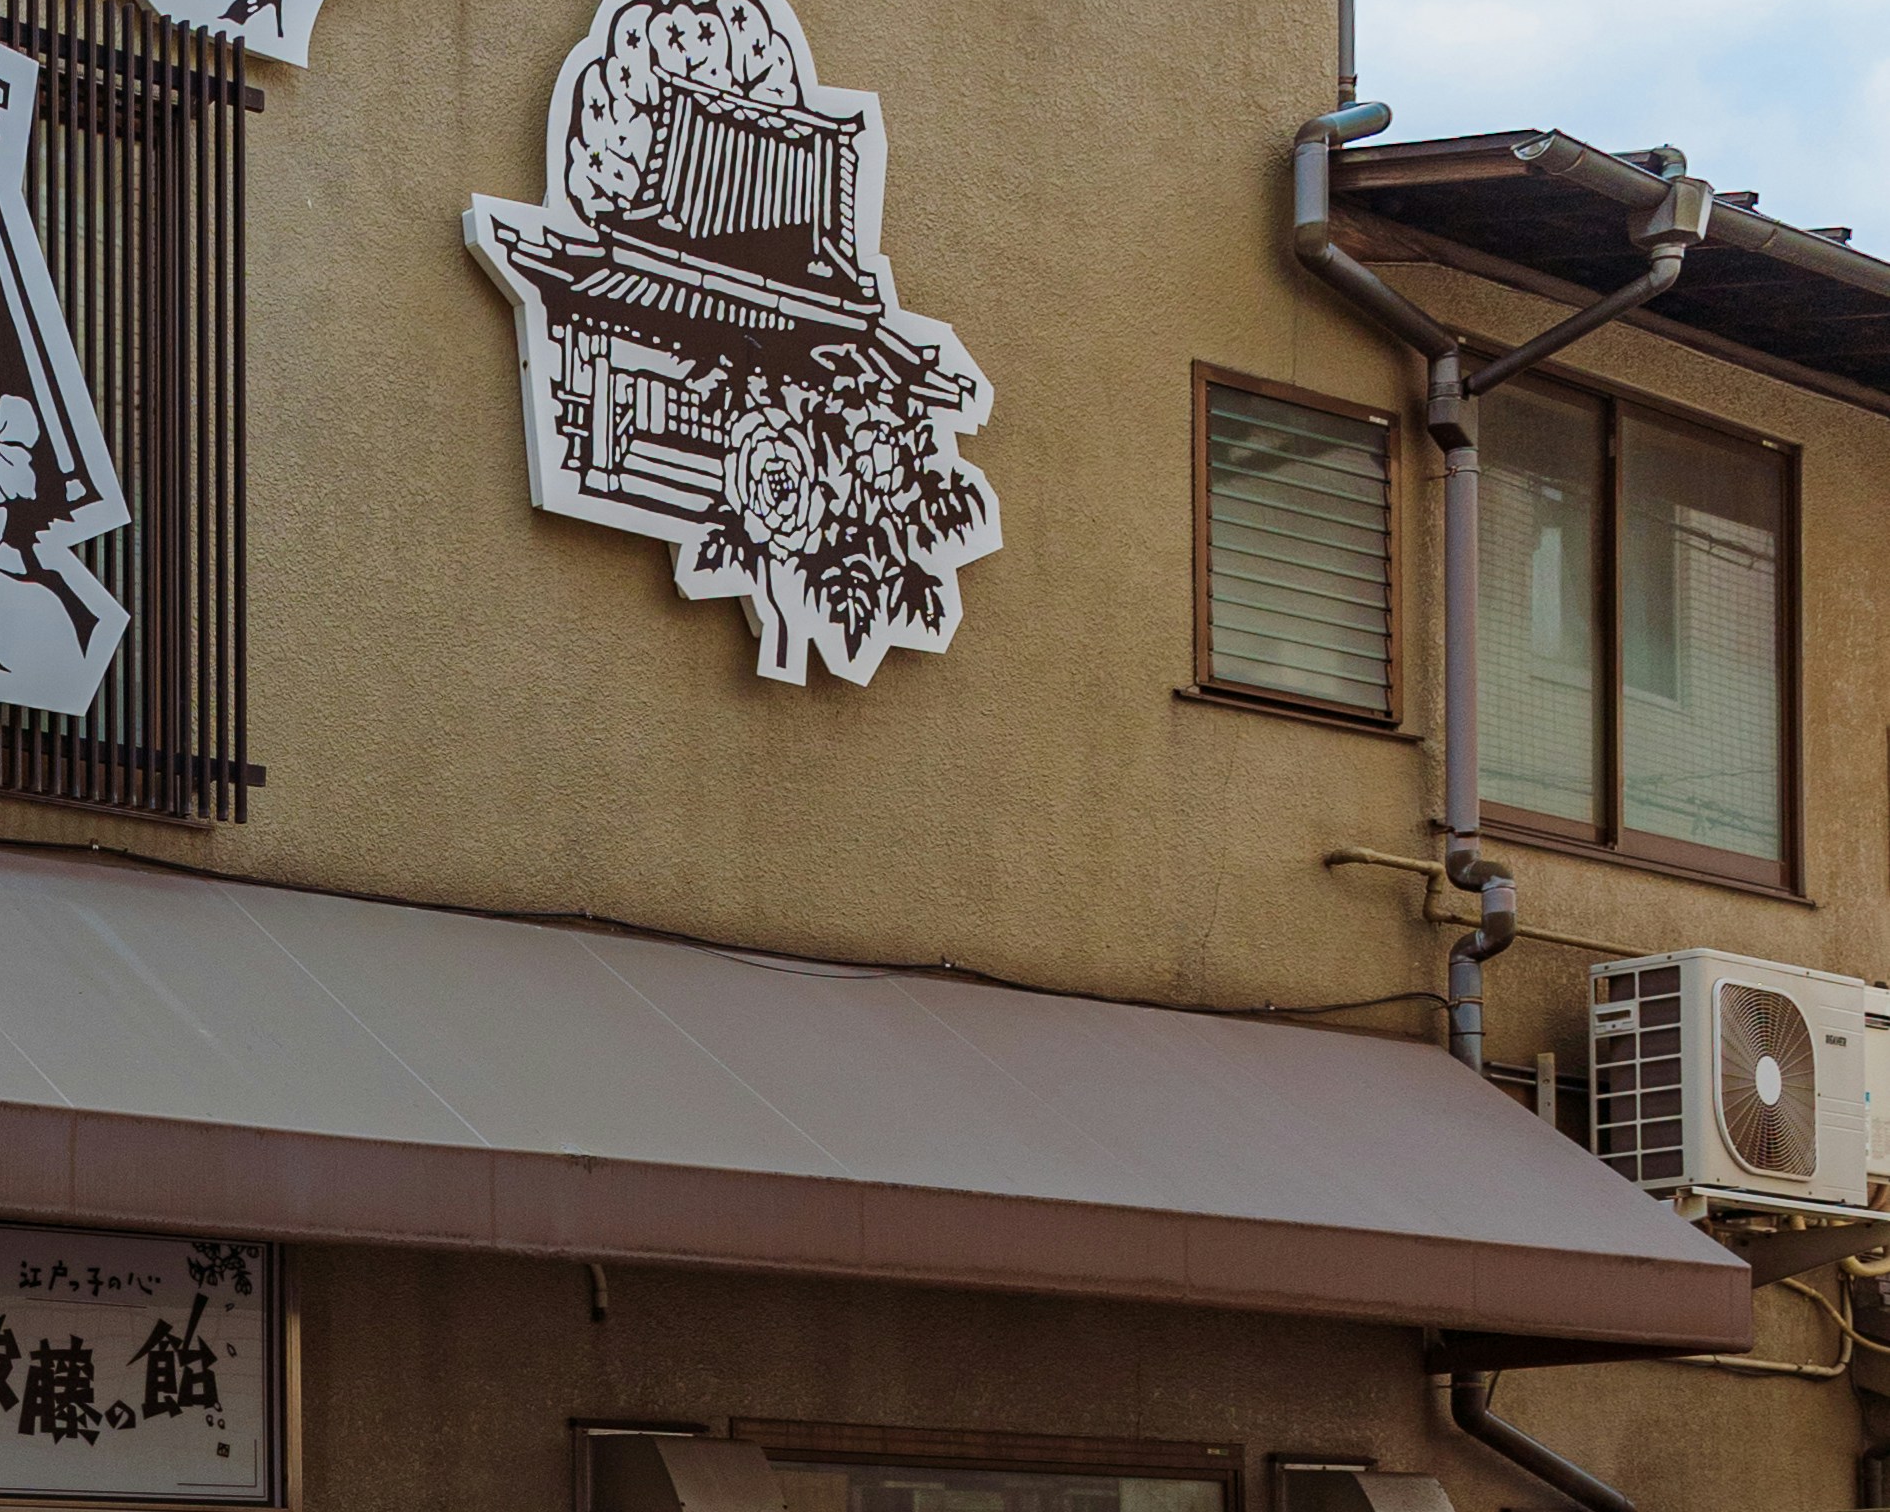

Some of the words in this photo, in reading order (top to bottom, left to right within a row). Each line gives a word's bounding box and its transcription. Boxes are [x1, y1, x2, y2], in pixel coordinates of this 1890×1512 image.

[19, 1260, 161, 1296] 江戸っ子の心
